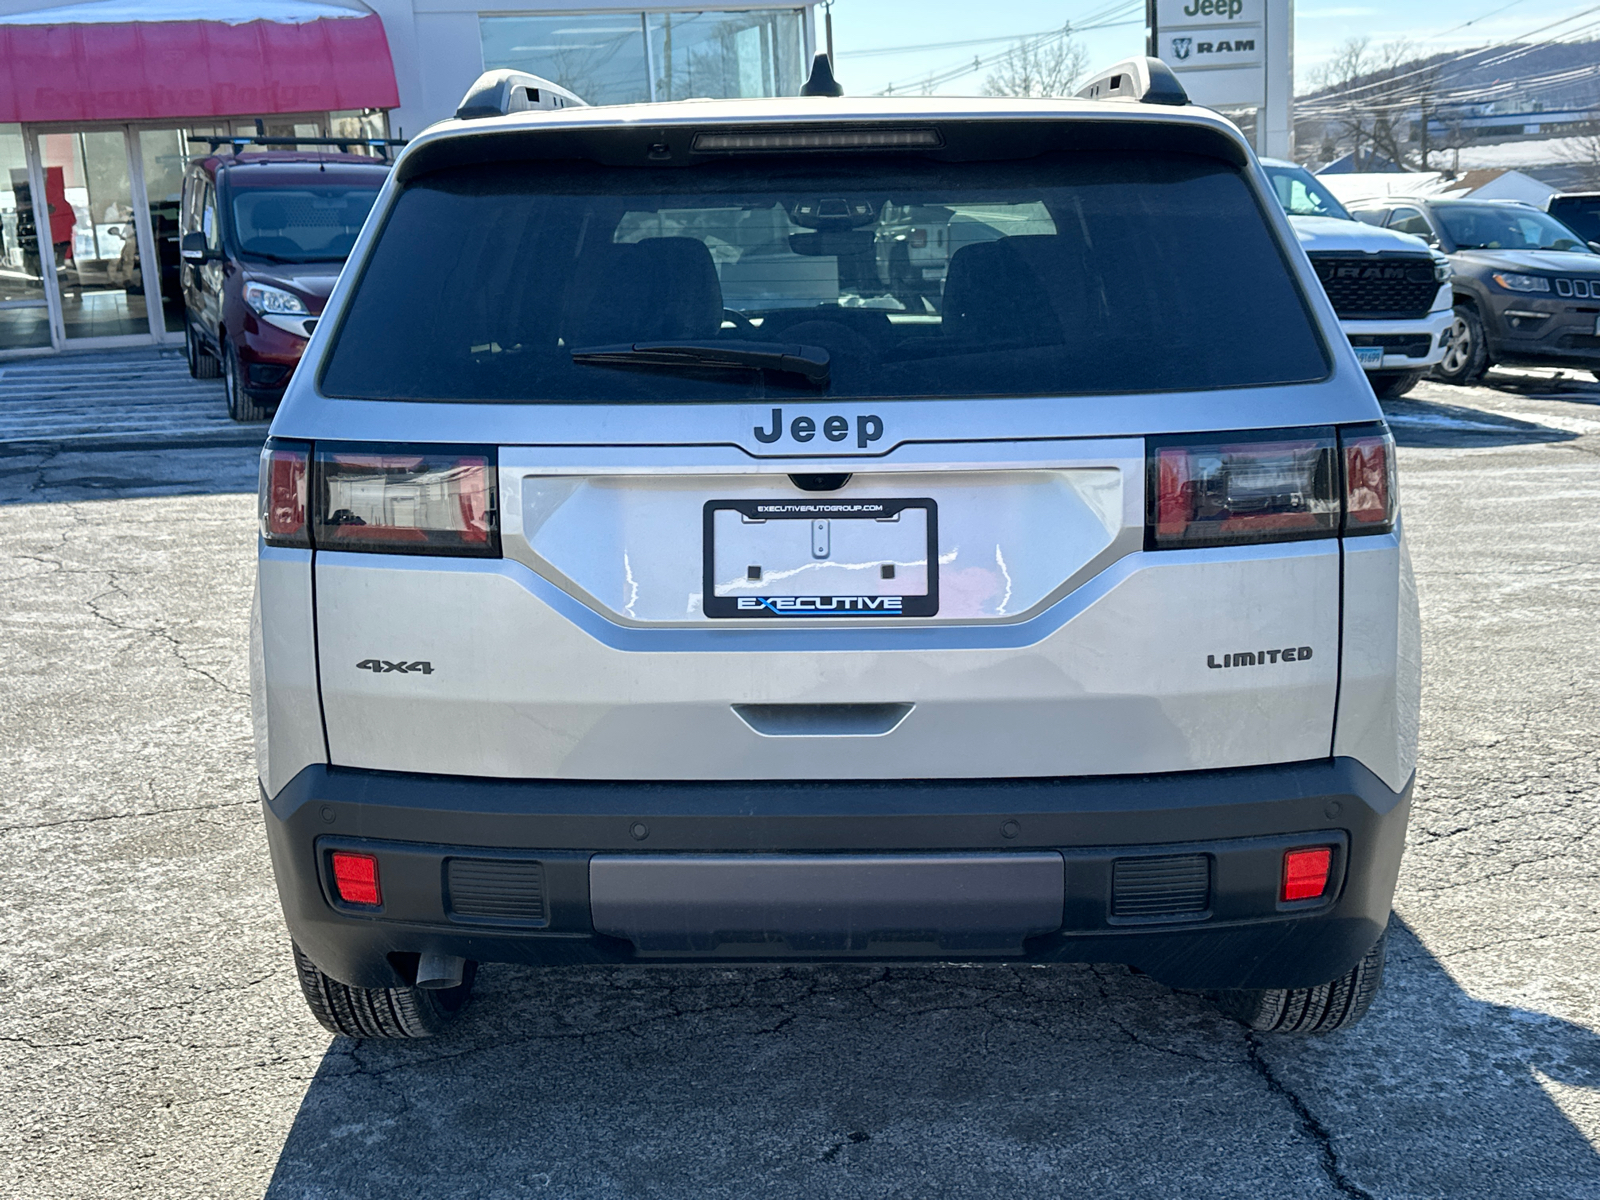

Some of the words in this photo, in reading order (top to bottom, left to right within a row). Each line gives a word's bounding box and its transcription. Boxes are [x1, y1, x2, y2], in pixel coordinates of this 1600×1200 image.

[1183, 0, 1243, 20] Jeep
[1197, 40, 1255, 54] RAM
[33, 84, 205, 110] Executive
[213, 80, 321, 108] Dodge
[1337, 267, 1404, 279] RAM
[753, 408, 884, 448] Jeep
[757, 504, 883, 513] EXECUTIVEAUTOGROUP.COM
[737, 596, 903, 615] EXECUTIVE
[1206, 645, 1314, 669] LIMITED
